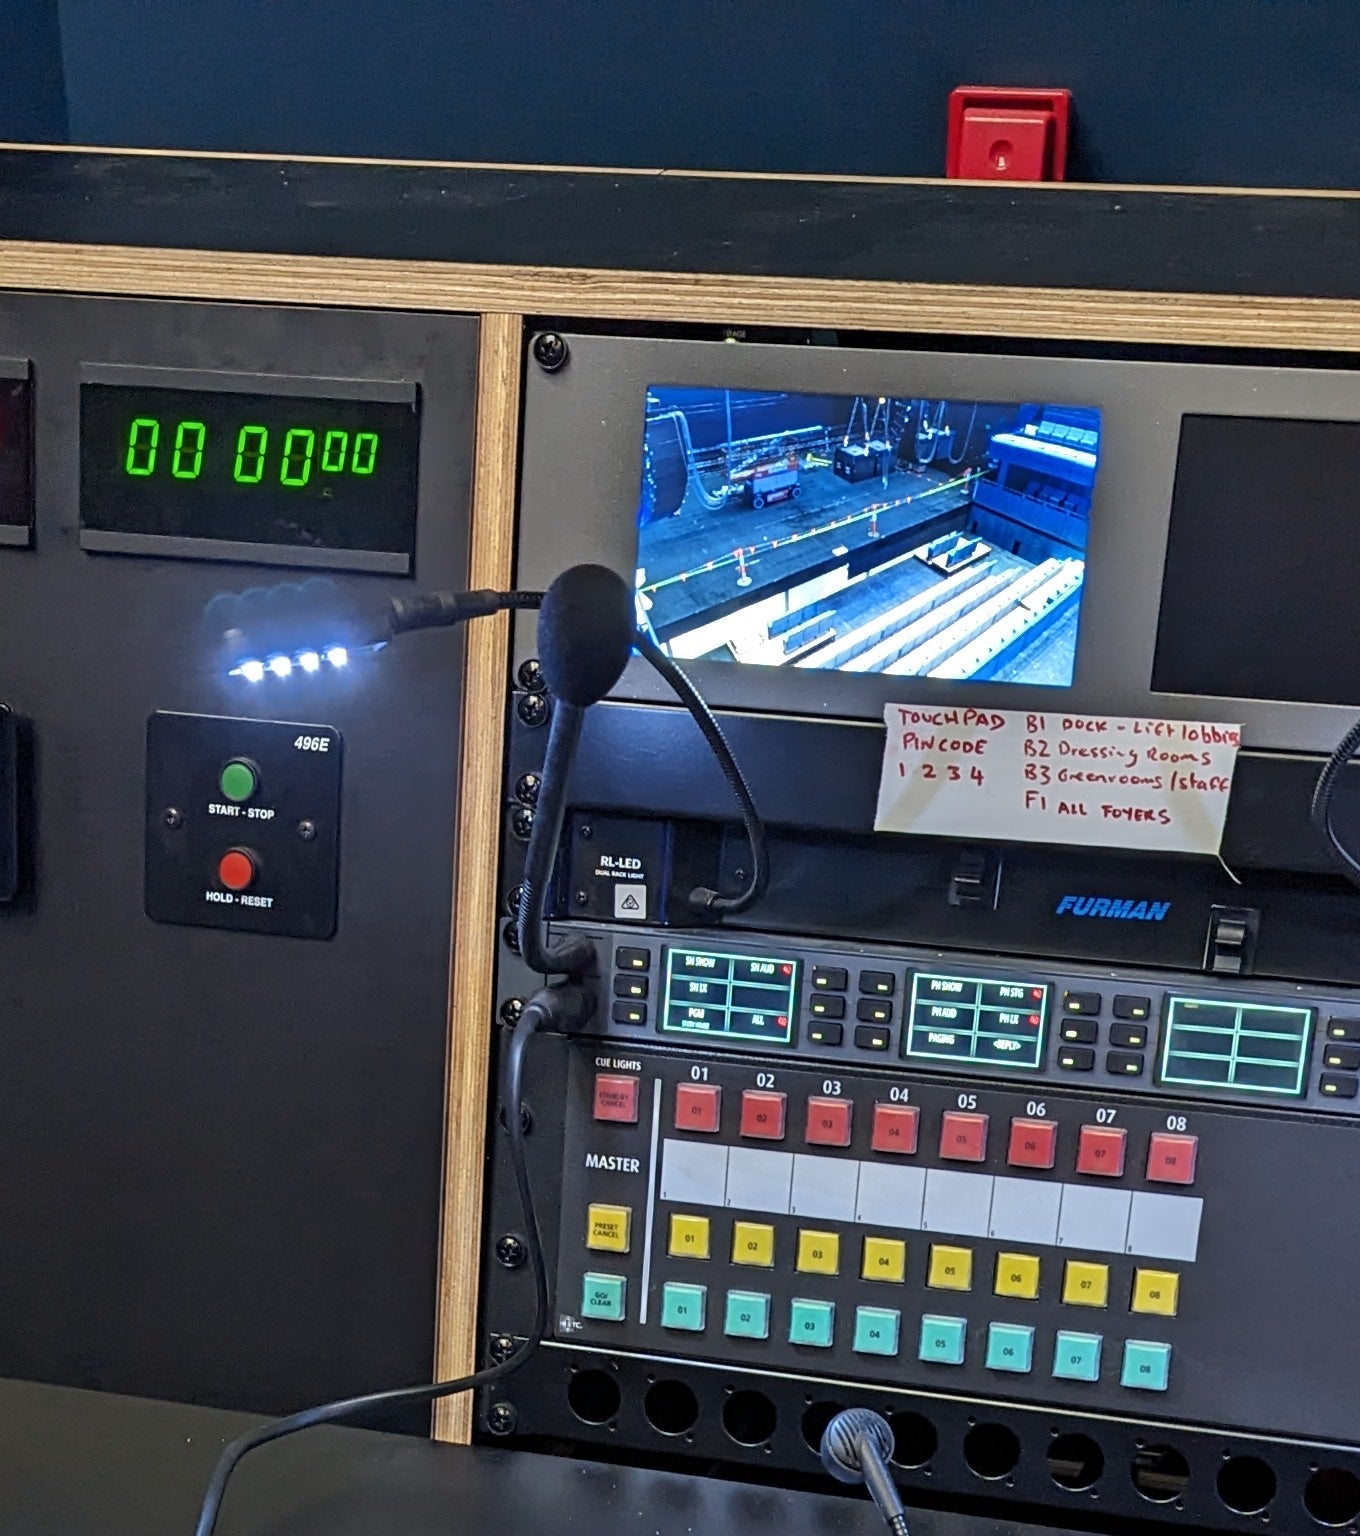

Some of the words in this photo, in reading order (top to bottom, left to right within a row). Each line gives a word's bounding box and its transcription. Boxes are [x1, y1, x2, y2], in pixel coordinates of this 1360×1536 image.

[126, 418, 206, 479] 00
[1026, 714, 1045, 734] B1
[1062, 718, 1108, 733] DOCK
[294, 735, 330, 752] 496E
[1024, 738, 1051, 757] B2
[1058, 740, 1138, 768] Dressing
[1146, 746, 1211, 766] Rooms
[899, 762, 905, 777] 1
[922, 763, 937, 778] 2
[947, 765, 961, 781] 3
[970, 766, 984, 786] 4
[1024, 763, 1051, 785] B3
[208, 803, 240, 817] START
[247, 807, 275, 820] STOP
[1025, 790, 1046, 811] F1
[1057, 801, 1088, 817] ALL
[1100, 804, 1171, 825] FOYERS
[600, 855, 642, 870] RL-LED
[594, 869, 611, 877] DUAL
[627, 872, 645, 880] LIGHT
[206, 891, 233, 904] HOLD
[241, 895, 274, 908] RESET
[1055, 895, 1172, 921] FURMAN
[595, 1056, 610, 1068] CUE
[613, 1058, 642, 1071] LIGHTS
[691, 1066, 708, 1081] 01
[756, 1072, 775, 1089] 02
[823, 1080, 842, 1096] 03
[890, 1087, 909, 1103] 04
[957, 1094, 977, 1110] 05
[1026, 1101, 1046, 1117] 06
[1096, 1108, 1116, 1124] 07
[1166, 1115, 1186, 1132] 08
[692, 1107, 701, 1115] 01
[757, 1114, 767, 1123] 02
[822, 1119, 833, 1128] 03
[888, 1128, 900, 1137] 04
[955, 1135, 967, 1143] 05
[1024, 1141, 1036, 1151] 06
[1095, 1150, 1106, 1158] 07
[1165, 1156, 1176, 1166] 08
[585, 1153, 640, 1173] MASTER
[593, 1229, 619, 1239] CANCEL
[594, 1222, 619, 1231] PRESET
[685, 1234, 695, 1243] 01
[748, 1242, 758, 1251] 02
[812, 1250, 823, 1259] 03
[878, 1257, 890, 1267] 04
[945, 1266, 955, 1275] 05
[1011, 1273, 1022, 1283] 06
[1080, 1280, 1092, 1289] 07
[1149, 1290, 1161, 1299] 08
[590, 1299, 612, 1307] CLEAR
[678, 1306, 688, 1314] 01
[740, 1313, 751, 1323] 02
[805, 1322, 815, 1331] 03
[869, 1330, 880, 1339] 04
[935, 1339, 946, 1348] 05
[1003, 1347, 1014, 1356] 06
[1071, 1356, 1082, 1364] 07
[1140, 1365, 1151, 1374] 08
